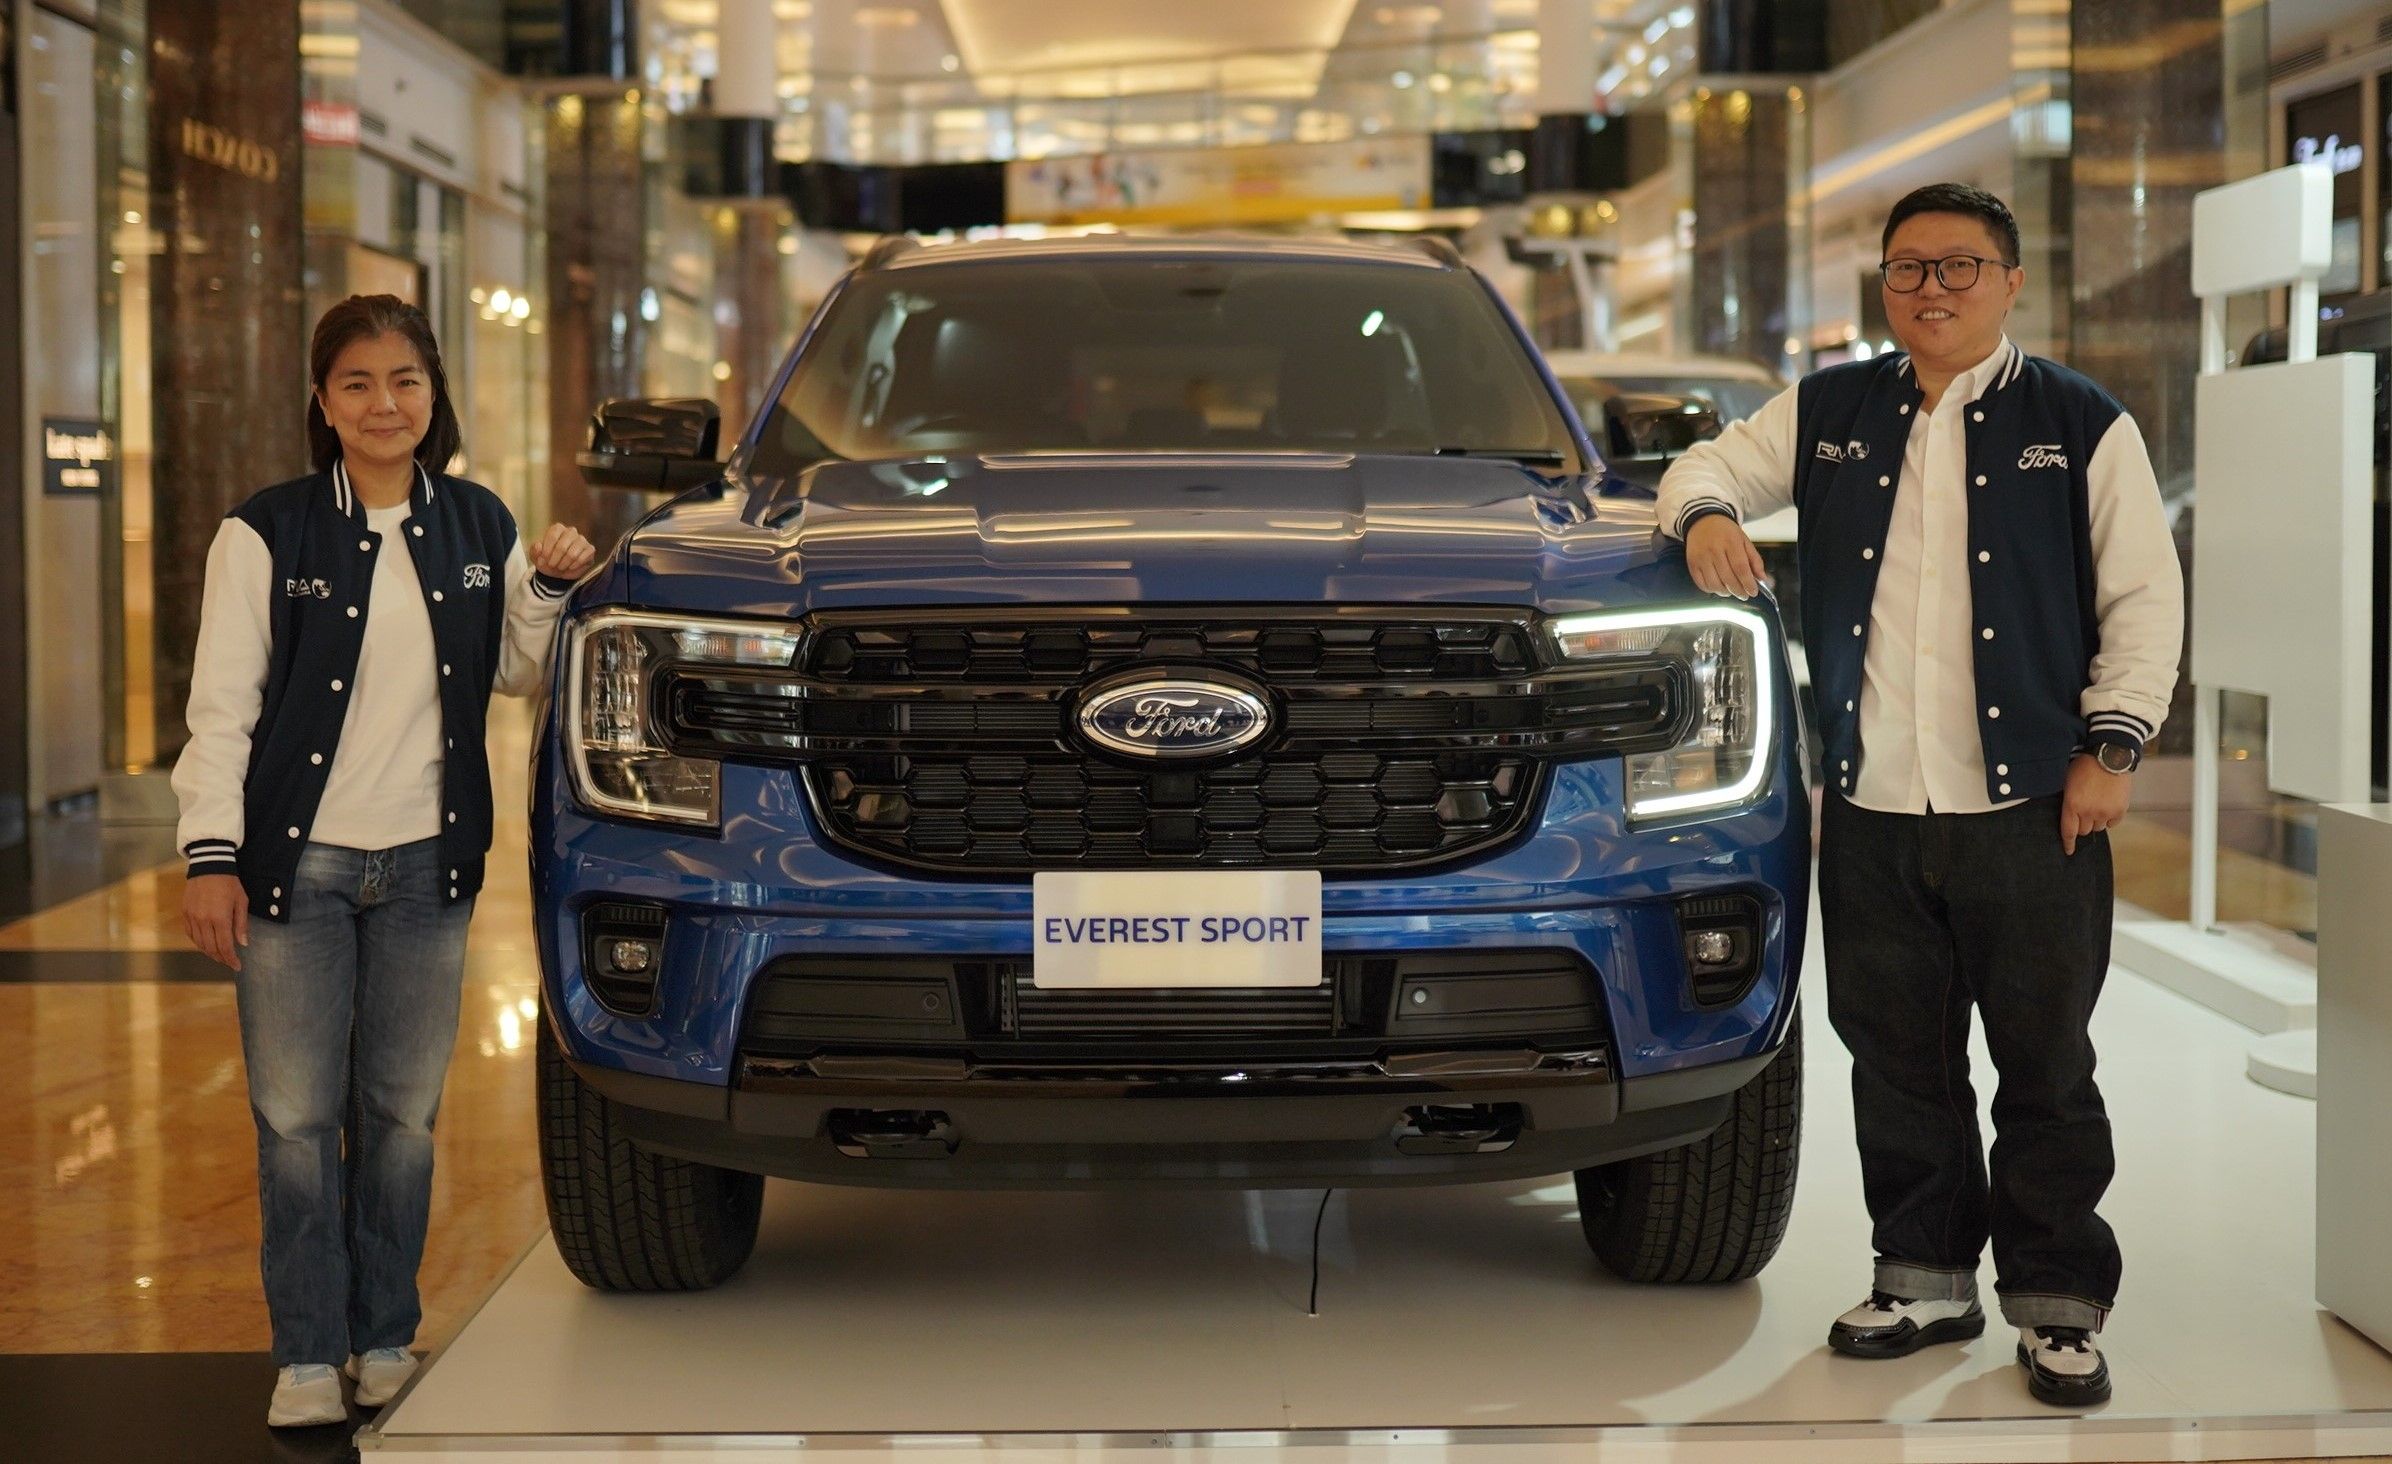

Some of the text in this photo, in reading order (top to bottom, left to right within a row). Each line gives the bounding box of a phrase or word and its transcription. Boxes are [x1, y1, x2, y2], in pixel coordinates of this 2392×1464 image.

[1125, 697, 1223, 738] Ford
[1045, 916, 1310, 943] EVEREST SPORT
